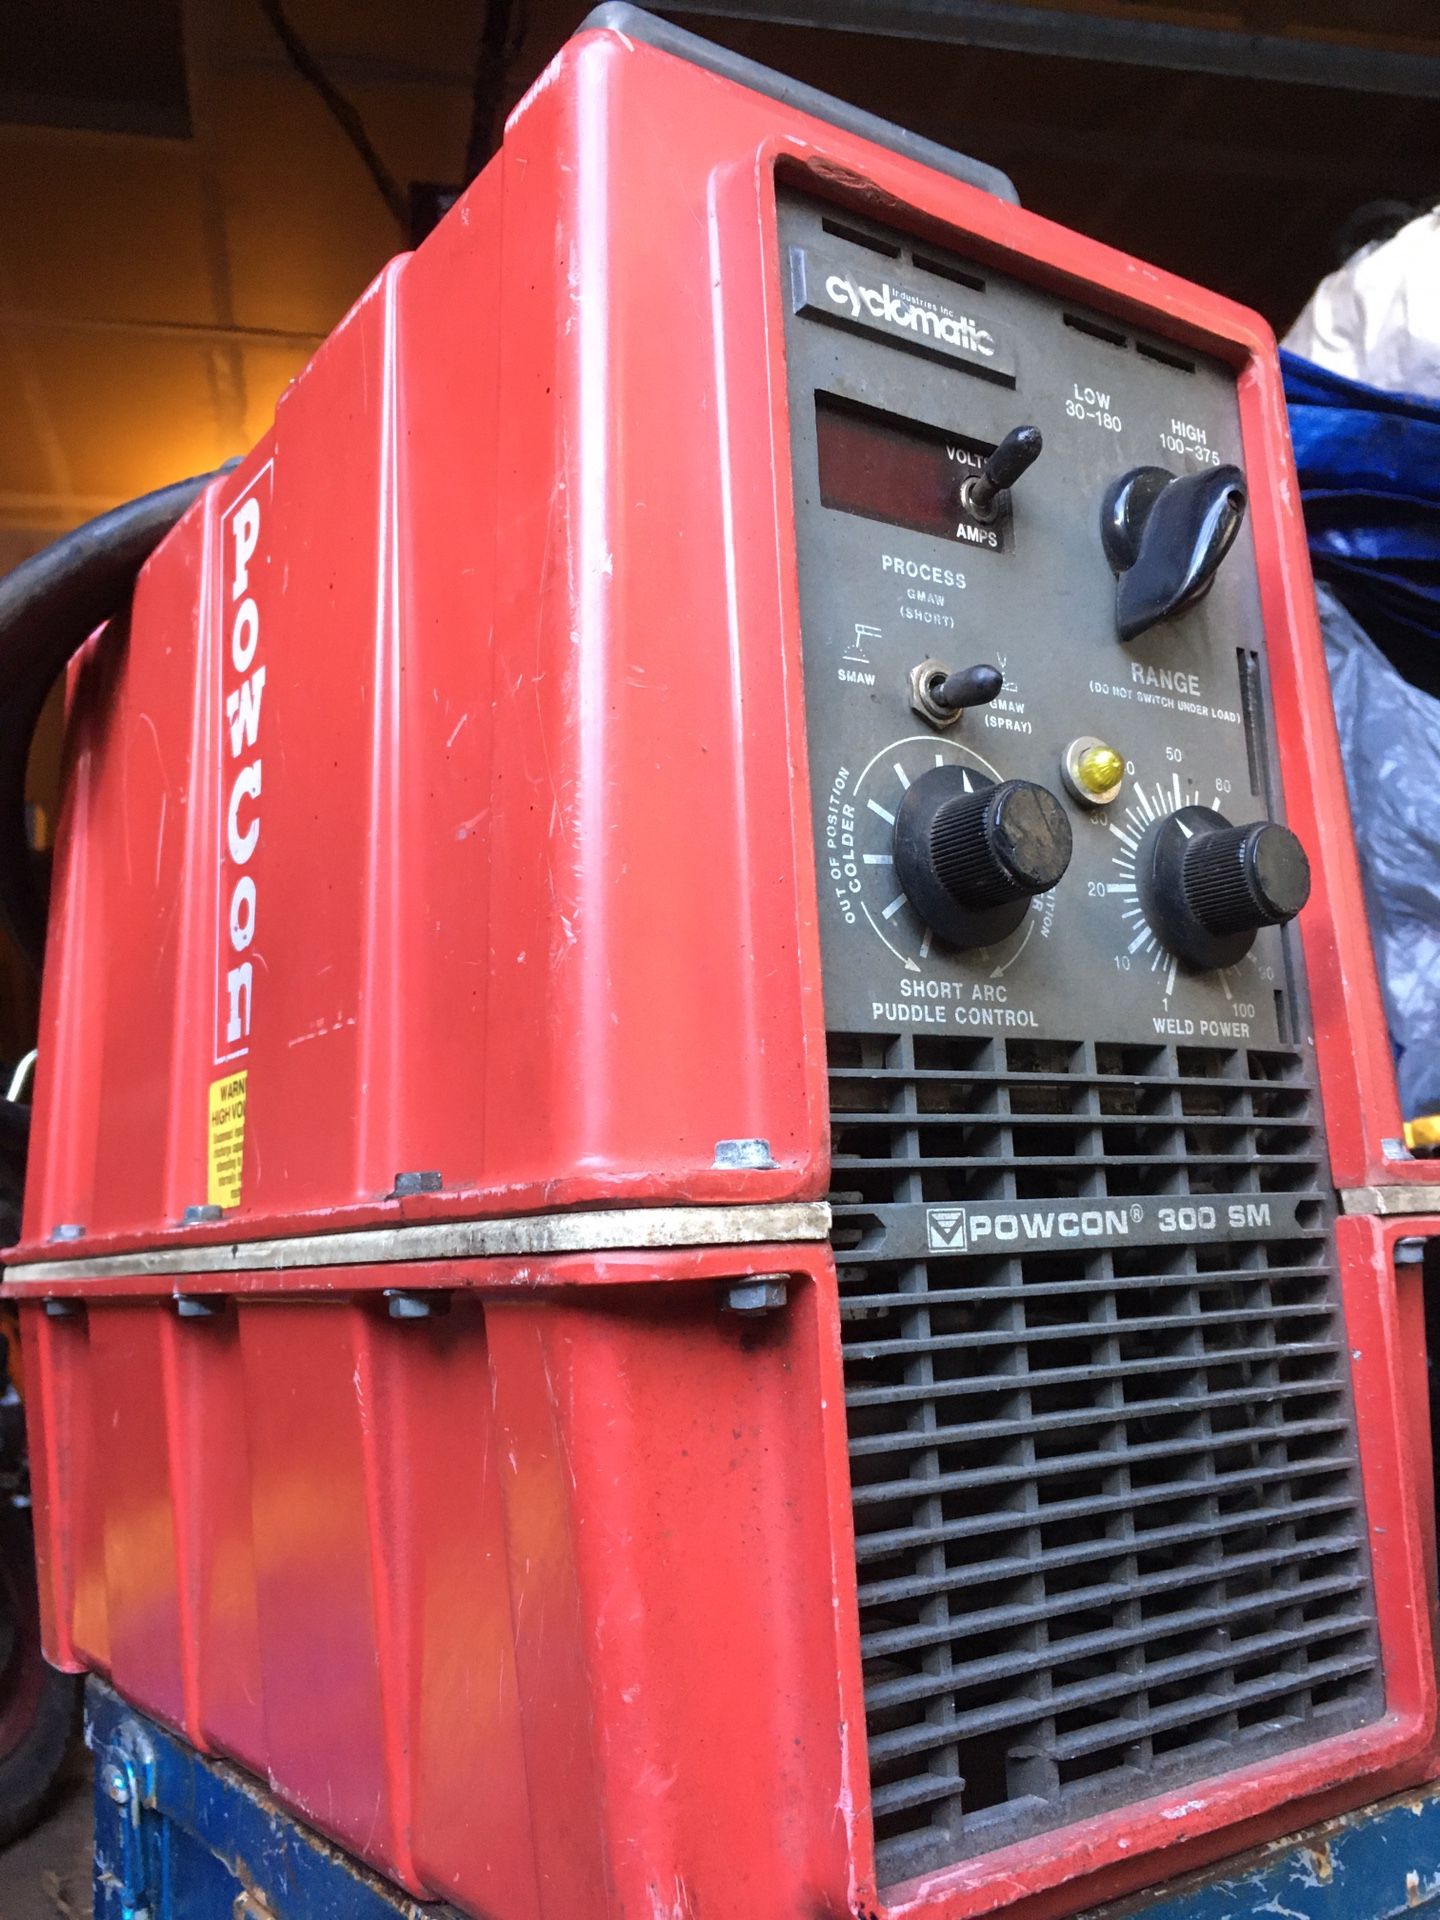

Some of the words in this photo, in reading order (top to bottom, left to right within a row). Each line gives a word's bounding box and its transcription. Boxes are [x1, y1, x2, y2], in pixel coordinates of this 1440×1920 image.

[1074, 383, 1110, 410] LOW
[1065, 400, 1122, 432] 30-180
[1171, 418, 1207, 445] HIGH
[946, 445, 988, 469] VOLT
[1159, 433, 1221, 466] 100-375
[956, 523, 998, 548] AMPS
[881, 555, 967, 589] PROCESS
[907, 588, 945, 606] GMAW
[900, 607, 955, 629] (SHORT)
[838, 669, 875, 686] SMAW
[1131, 662, 1201, 697] RANGE
[989, 699, 1025, 714] GMAW
[1089, 680, 1110, 694] (DO
[1112, 686, 1133, 699] NOT
[1136, 691, 1175, 709] SWITCH
[1177, 701, 1209, 717] UNDER
[1211, 707, 1242, 724] LOAD)
[984, 714, 1032, 734] (SPRAY)
[1165, 746, 1183, 763] 50
[1124, 761, 1135, 776] 0
[827, 766, 850, 849] POSITION
[842, 805, 862, 893] COLDER
[829, 861, 841, 880] OF
[1087, 882, 1106, 897] 20
[836, 887, 856, 924] OUT
[1114, 955, 1131, 971] 10
[900, 979, 963, 1001] SHORT
[972, 983, 1008, 1003] ARC
[872, 1002, 947, 1023] PUDDLE
[955, 1007, 1040, 1028] CONTROL
[1162, 998, 1168, 1012] 1
[1231, 1003, 1256, 1018] 100
[1152, 1017, 1194, 1035] WELD
[1200, 1020, 1250, 1038] POWER
[220, 1078, 247, 1101] WARN
[211, 1105, 231, 1128] HIGH
[1158, 1206, 1216, 1232] 300
[1228, 1203, 1272, 1228] SM
